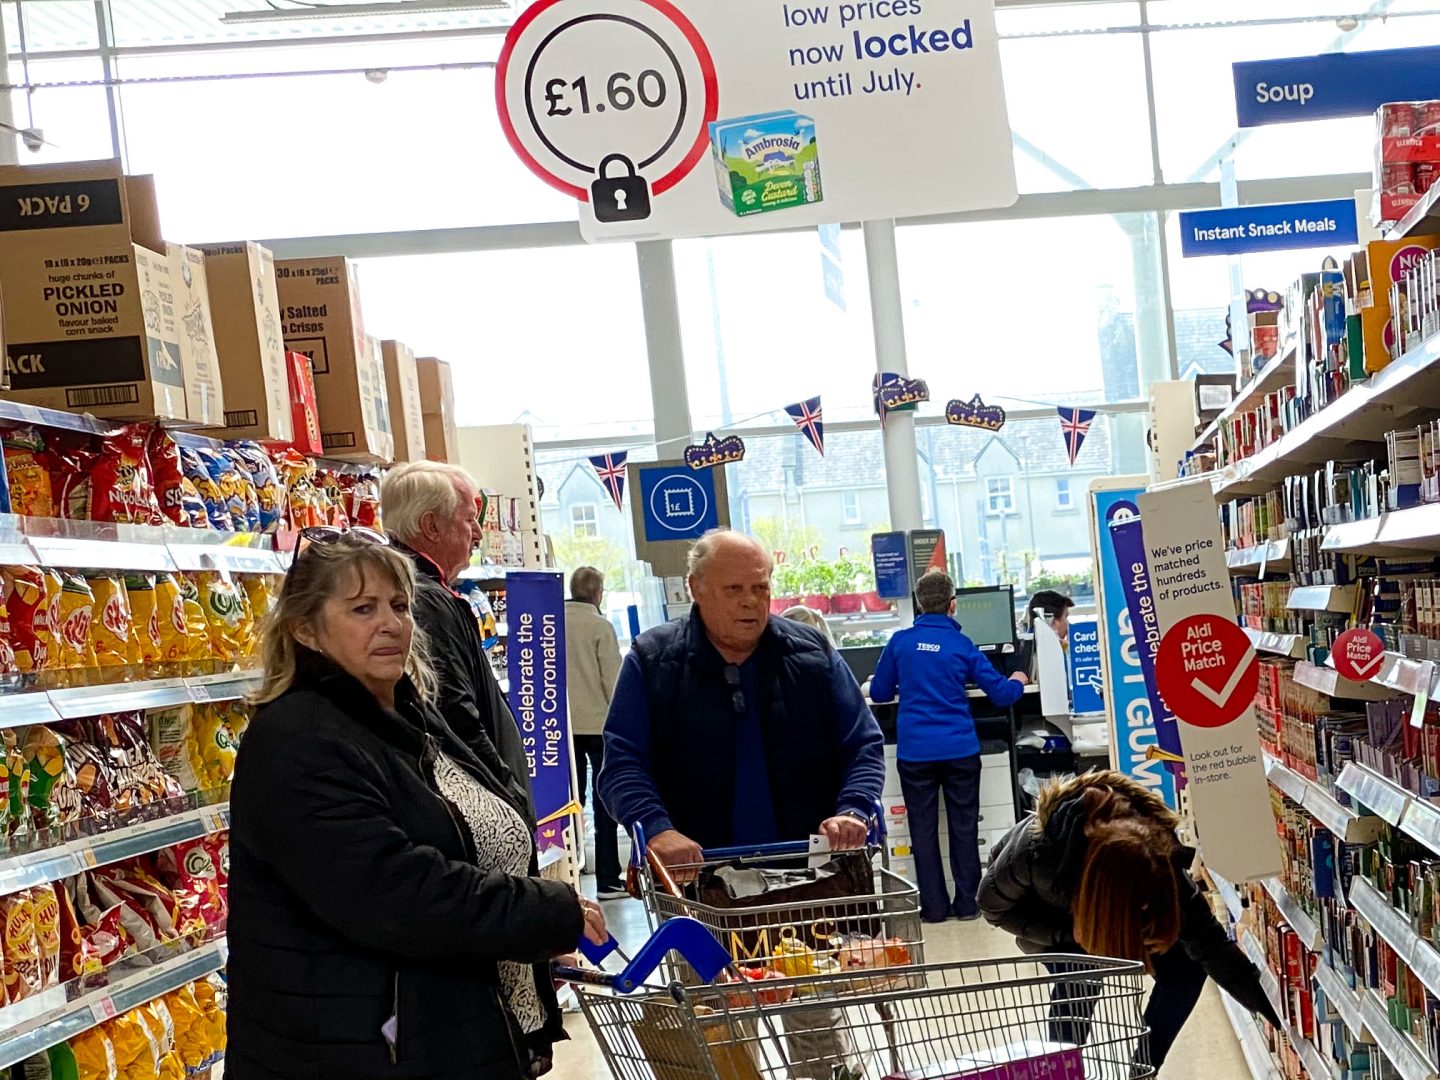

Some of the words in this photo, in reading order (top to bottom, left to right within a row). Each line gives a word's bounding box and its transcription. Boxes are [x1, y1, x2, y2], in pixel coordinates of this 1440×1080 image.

[783, 3, 835, 28] low
[839, 0, 922, 28] prices
[789, 45, 844, 67] now
[854, 19, 974, 60] locked
[544, 69, 667, 117] £1.60
[794, 73, 852, 101] until
[861, 69, 922, 96] July.
[1256, 81, 1314, 104] Soup
[745, 136, 800, 160] Ambrosia
[17, 194, 72, 216] PACK
[77, 194, 91, 212] 6
[1194, 224, 1245, 241] Instant
[1248, 221, 1292, 237] Snack
[1295, 217, 1336, 232] Meals
[48, 274, 71, 283] huge
[73, 271, 104, 280] chunks
[106, 270, 115, 279] of
[316, 276, 339, 285] PACKS
[43, 283, 125, 301] PICKLED
[55, 299, 118, 317] ONION
[287, 304, 327, 319] Salted
[59, 318, 89, 327] flavour
[91, 316, 119, 326] baked
[88, 325, 114, 334] snack
[289, 322, 324, 334] Crisps
[8, 354, 45, 374] ACK
[1151, 545, 1182, 559] We've
[1185, 539, 1213, 554] price
[1154, 555, 1200, 573] matched
[1131, 562, 1148, 593] the
[1157, 568, 1206, 587] hundreds
[1159, 589, 1170, 600] of
[1172, 580, 1224, 600] products.
[516, 612, 533, 643] the
[1074, 631, 1097, 641] Card
[1187, 623, 1212, 641] Aldi
[916, 642, 940, 652] TESCO
[1181, 639, 1222, 658] Price
[1346, 643, 1372, 653] Price
[1352, 635, 1368, 643] Aldi
[540, 613, 557, 713] Coronation
[1184, 653, 1226, 672] Match
[1346, 652, 1371, 660] Match
[518, 648, 535, 732] celebrate
[541, 717, 562, 767] King's
[1190, 750, 1211, 762] Look
[1213, 747, 1228, 757] out
[1230, 744, 1243, 754] for
[1192, 763, 1208, 773] the
[1209, 759, 1225, 769] red
[1226, 754, 1257, 767] bubble
[9, 909, 31, 939] HULA
